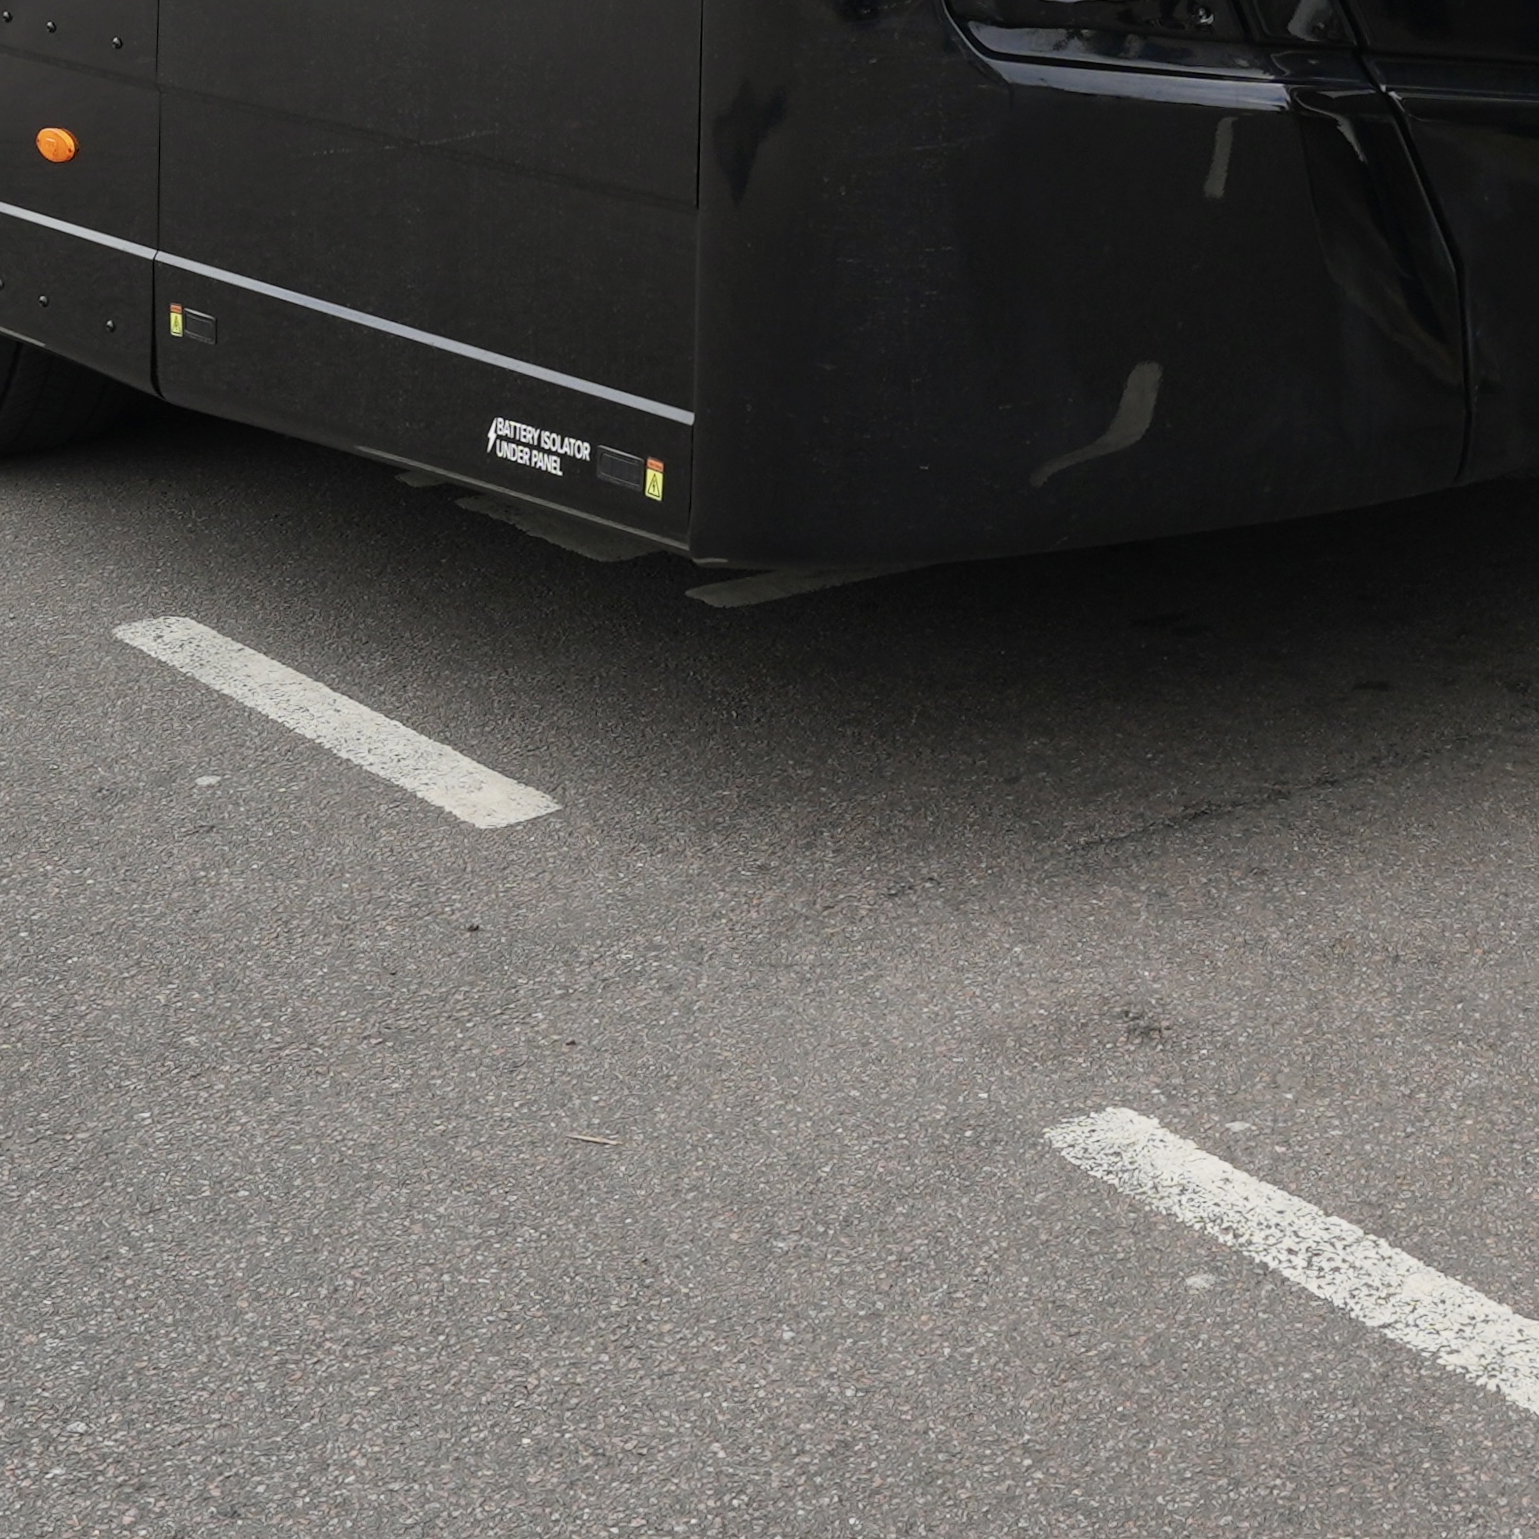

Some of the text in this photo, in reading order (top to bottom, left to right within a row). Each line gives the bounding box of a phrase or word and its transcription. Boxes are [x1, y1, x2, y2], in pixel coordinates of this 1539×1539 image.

[495, 439, 563, 476] UNDER PANEL
[496, 417, 591, 462] BATTERY ISOLATOR
